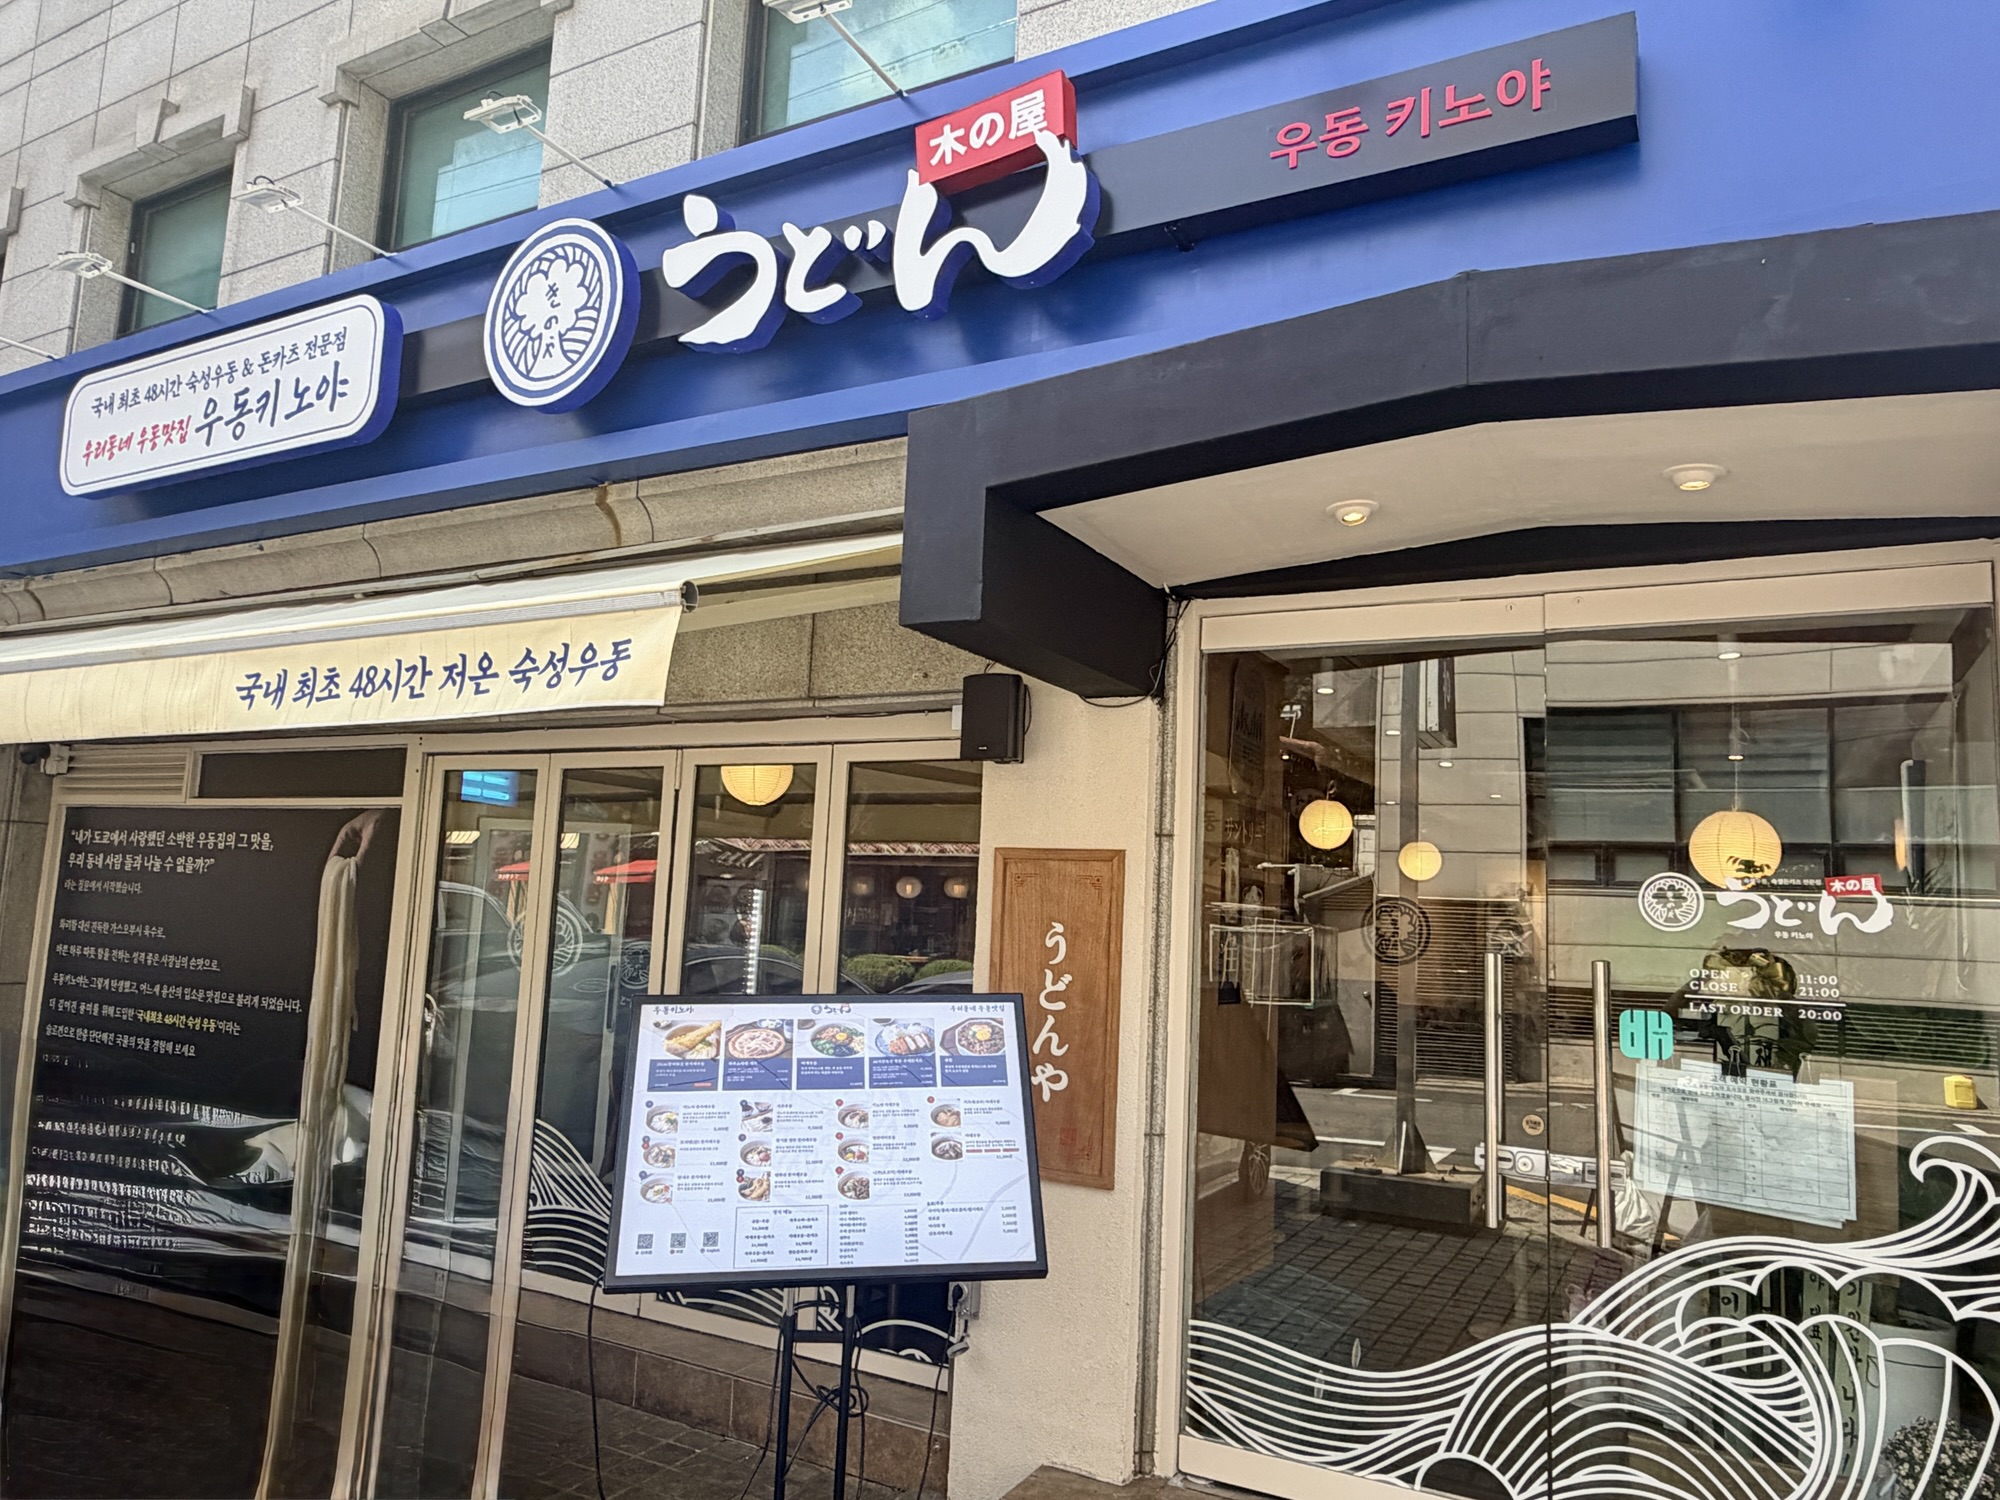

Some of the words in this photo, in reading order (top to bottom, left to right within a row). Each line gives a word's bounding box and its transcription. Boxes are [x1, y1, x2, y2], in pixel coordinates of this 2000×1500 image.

[928, 88, 1049, 168] 木の屋
[1269, 105, 1369, 169] 우동
[1385, 57, 1552, 138] 키노야
[661, 131, 1088, 346] うどん
[91, 396, 115, 419] 국내
[118, 387, 142, 413] 최초
[144, 374, 183, 404] 48시간
[185, 360, 239, 393] 숙성우동
[242, 360, 255, 377] &
[258, 343, 301, 374] 돈카츠
[303, 326, 348, 360] 전문점
[82, 432, 133, 467] 우리동네
[135, 415, 192, 455] 우동맛집
[194, 360, 350, 447] 우동키노야
[235, 667, 289, 712] 국내
[292, 665, 342, 709] 최초
[348, 654, 433, 704] 48시간
[438, 650, 500, 697] 저온
[507, 638, 633, 693] 숙성우동
[67, 851, 84, 868] 우리
[86, 854, 103, 869] 동네
[104, 854, 122, 870] 사람
[94, 830, 126, 847] 도쿄에서
[129, 831, 166, 848] 사랑했던
[166, 832, 195, 849] 소박한
[197, 832, 235, 851] 우동집의
[237, 833, 248, 849] 그
[250, 832, 274, 852] 맛을,
[1716, 877, 1893, 935] うどん
[1829, 877, 1877, 893] 木の屋
[1689, 968, 1730, 980] OPEN
[1798, 973, 1839, 986] 11:00
[1689, 980, 1738, 993] CLOSE
[1799, 986, 1840, 998] 21:00
[1030, 921, 1073, 1103] うどんや
[1689, 1002, 1727, 1015] LAST
[1730, 1004, 1784, 1018] ORDER
[1798, 1009, 1843, 1022] 20:00
